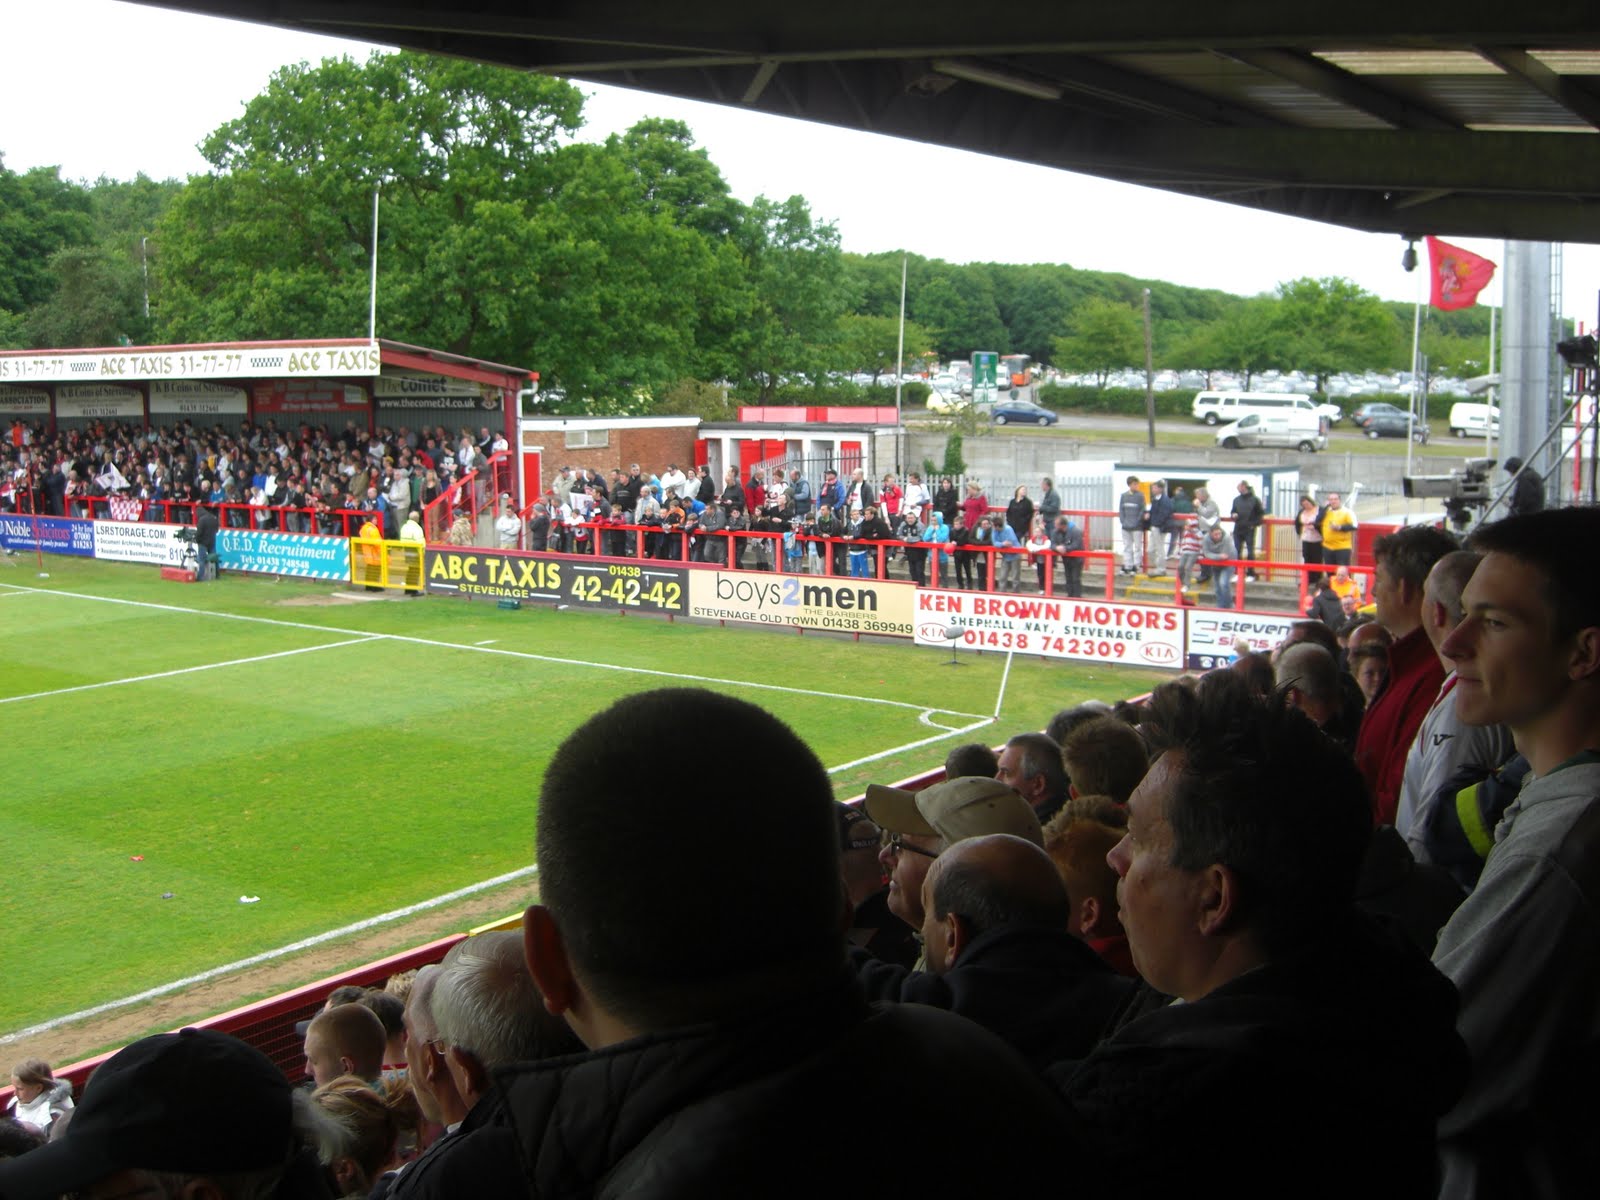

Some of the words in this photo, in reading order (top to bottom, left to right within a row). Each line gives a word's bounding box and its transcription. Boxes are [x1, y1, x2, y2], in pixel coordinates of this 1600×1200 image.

[15, 359, 64, 377] 31-77-77
[131, 356, 172, 375] TAXIS
[180, 354, 242, 375] 31-77-77
[326, 350, 380, 371] TAXIS
[380, 398, 476, 409] www.thecomet24.co.uk
[5, 520, 31, 537] Noble
[95, 525, 167, 539] LSRSTORAGE.COM
[259, 539, 336, 560] Recruitment
[241, 554, 255, 564] Tel:
[257, 556, 280, 566] 01438
[430, 553, 478, 583] ABC
[486, 558, 561, 590] TAXIS
[609, 565, 641, 578] 01438
[459, 584, 529, 599] STEVENAGE
[571, 575, 682, 610] 42-42-42
[694, 606, 757, 621] STEVENAGE
[760, 613, 782, 625] OLD
[785, 615, 818, 627] TOWN
[823, 617, 860, 630] 01438
[864, 620, 913, 634] 369949
[803, 608, 823, 616] THE
[826, 609, 877, 620] BARBERS
[920, 593, 962, 613] KEN
[974, 598, 1060, 621] BROWN
[1073, 605, 1178, 631] MOTORS
[951, 616, 1014, 630] SHEPHALL
[1064, 625, 1142, 641] STEVENAGE
[964, 629, 1028, 649] 01438
[1041, 636, 1126, 658] 742309
[1145, 646, 1174, 659] KIA
